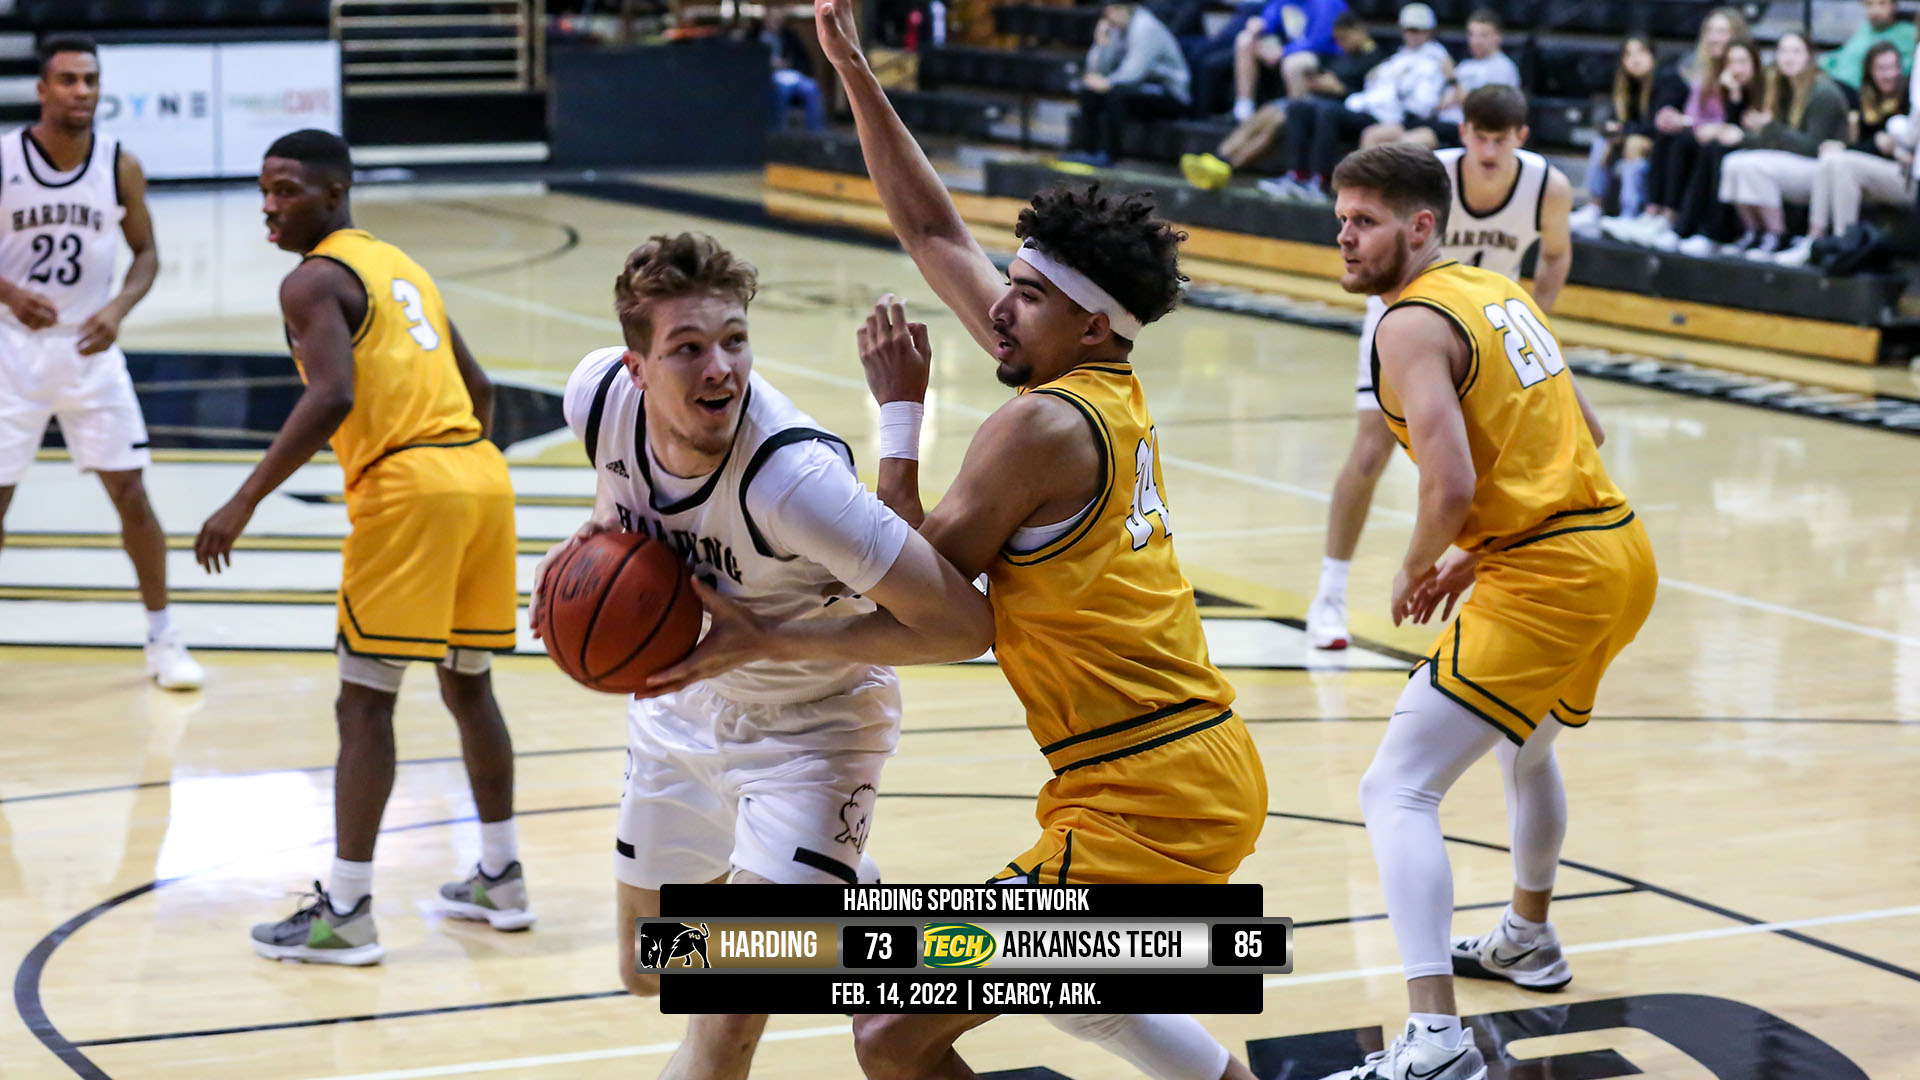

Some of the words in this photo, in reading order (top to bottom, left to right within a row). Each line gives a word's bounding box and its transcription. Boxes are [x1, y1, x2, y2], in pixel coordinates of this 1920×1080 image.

[12, 204, 103, 232] HARDING
[28, 234, 82, 285] 23
[391, 278, 440, 351] 3
[1483, 298, 1565, 390] 20
[1124, 424, 1172, 552] 34
